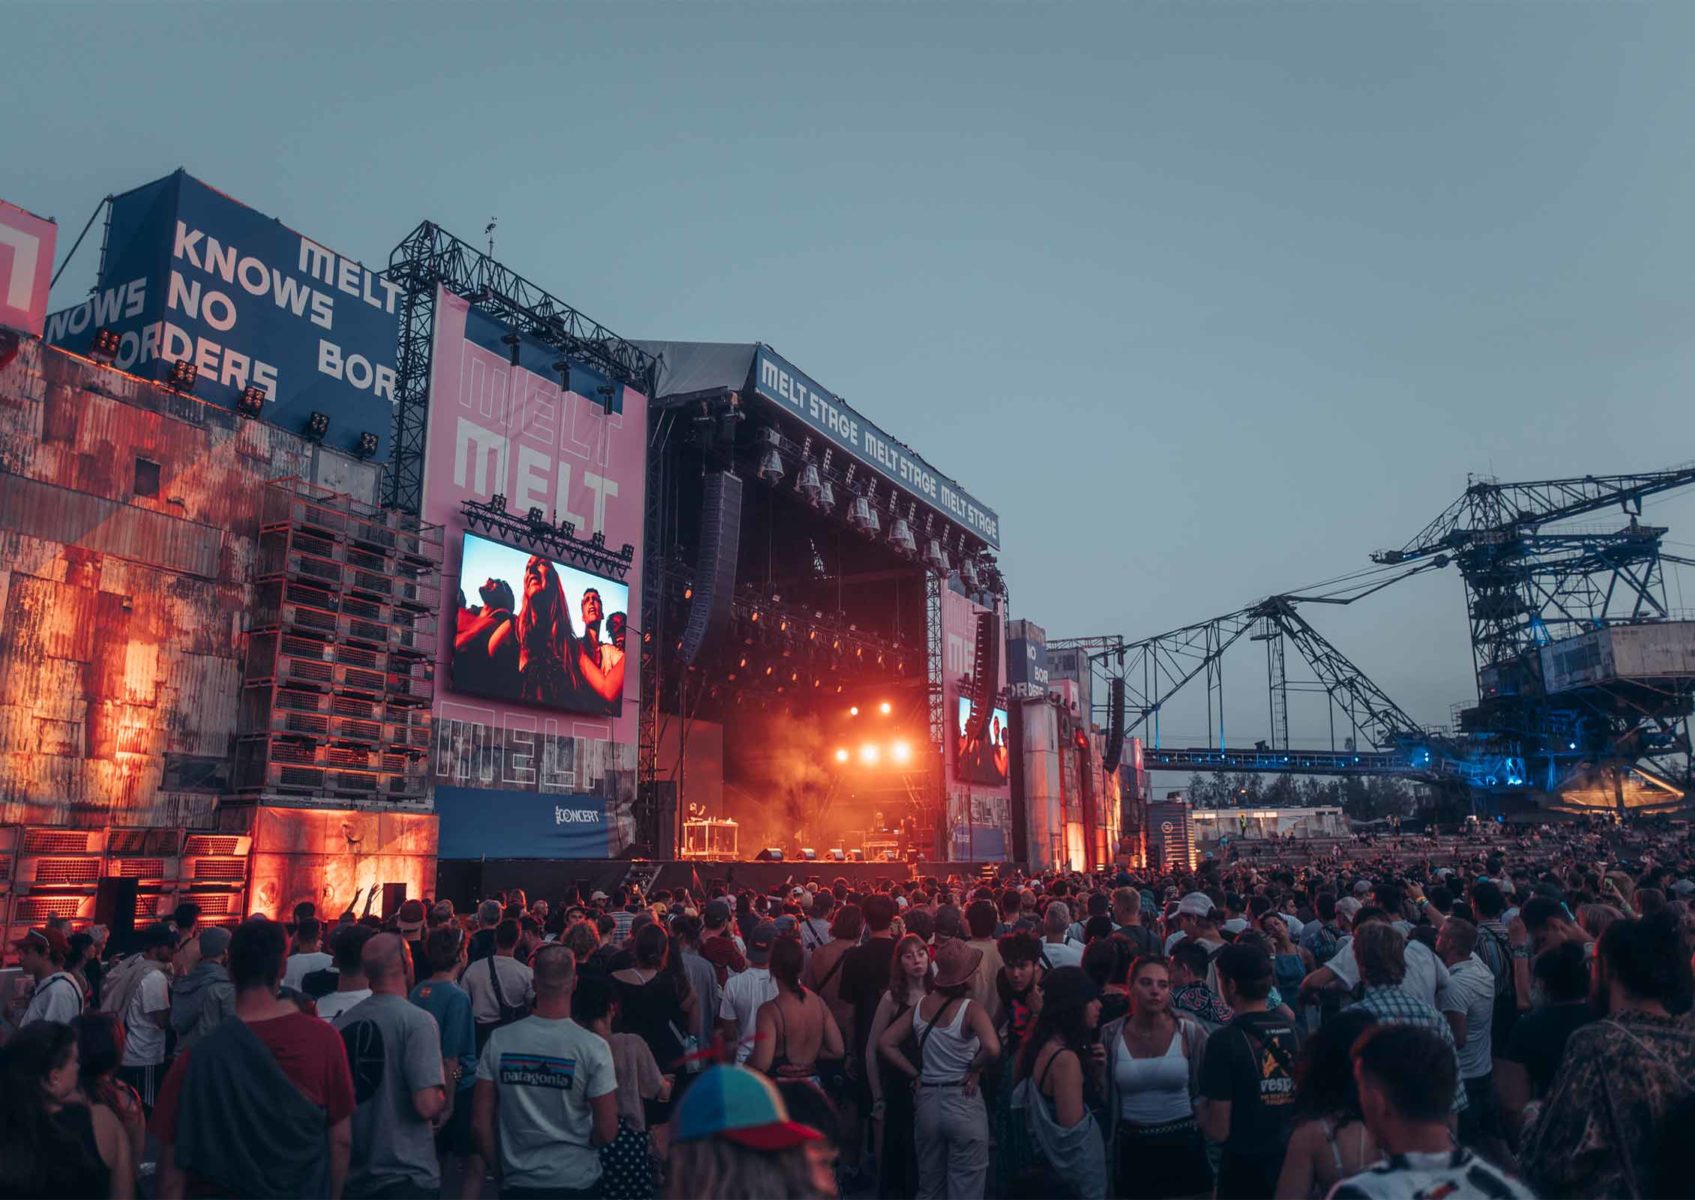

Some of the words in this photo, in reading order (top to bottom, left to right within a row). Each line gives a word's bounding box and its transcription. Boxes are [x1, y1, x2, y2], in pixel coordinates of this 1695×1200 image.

[167, 270, 237, 332] NO
[174, 219, 334, 331] KNOWS
[298, 236, 405, 314] MELT
[458, 338, 623, 469] MELT
[761, 358, 807, 409] MELT
[809, 391, 859, 446] STAGE
[865, 431, 898, 471] MELT
[900, 455, 937, 499] STAGE
[941, 484, 967, 518] MELT
[967, 502, 997, 539] STAGE
[453, 416, 619, 536] MELT
[436, 701, 610, 790] MELT
[503, 1069, 569, 1086] patagonia
